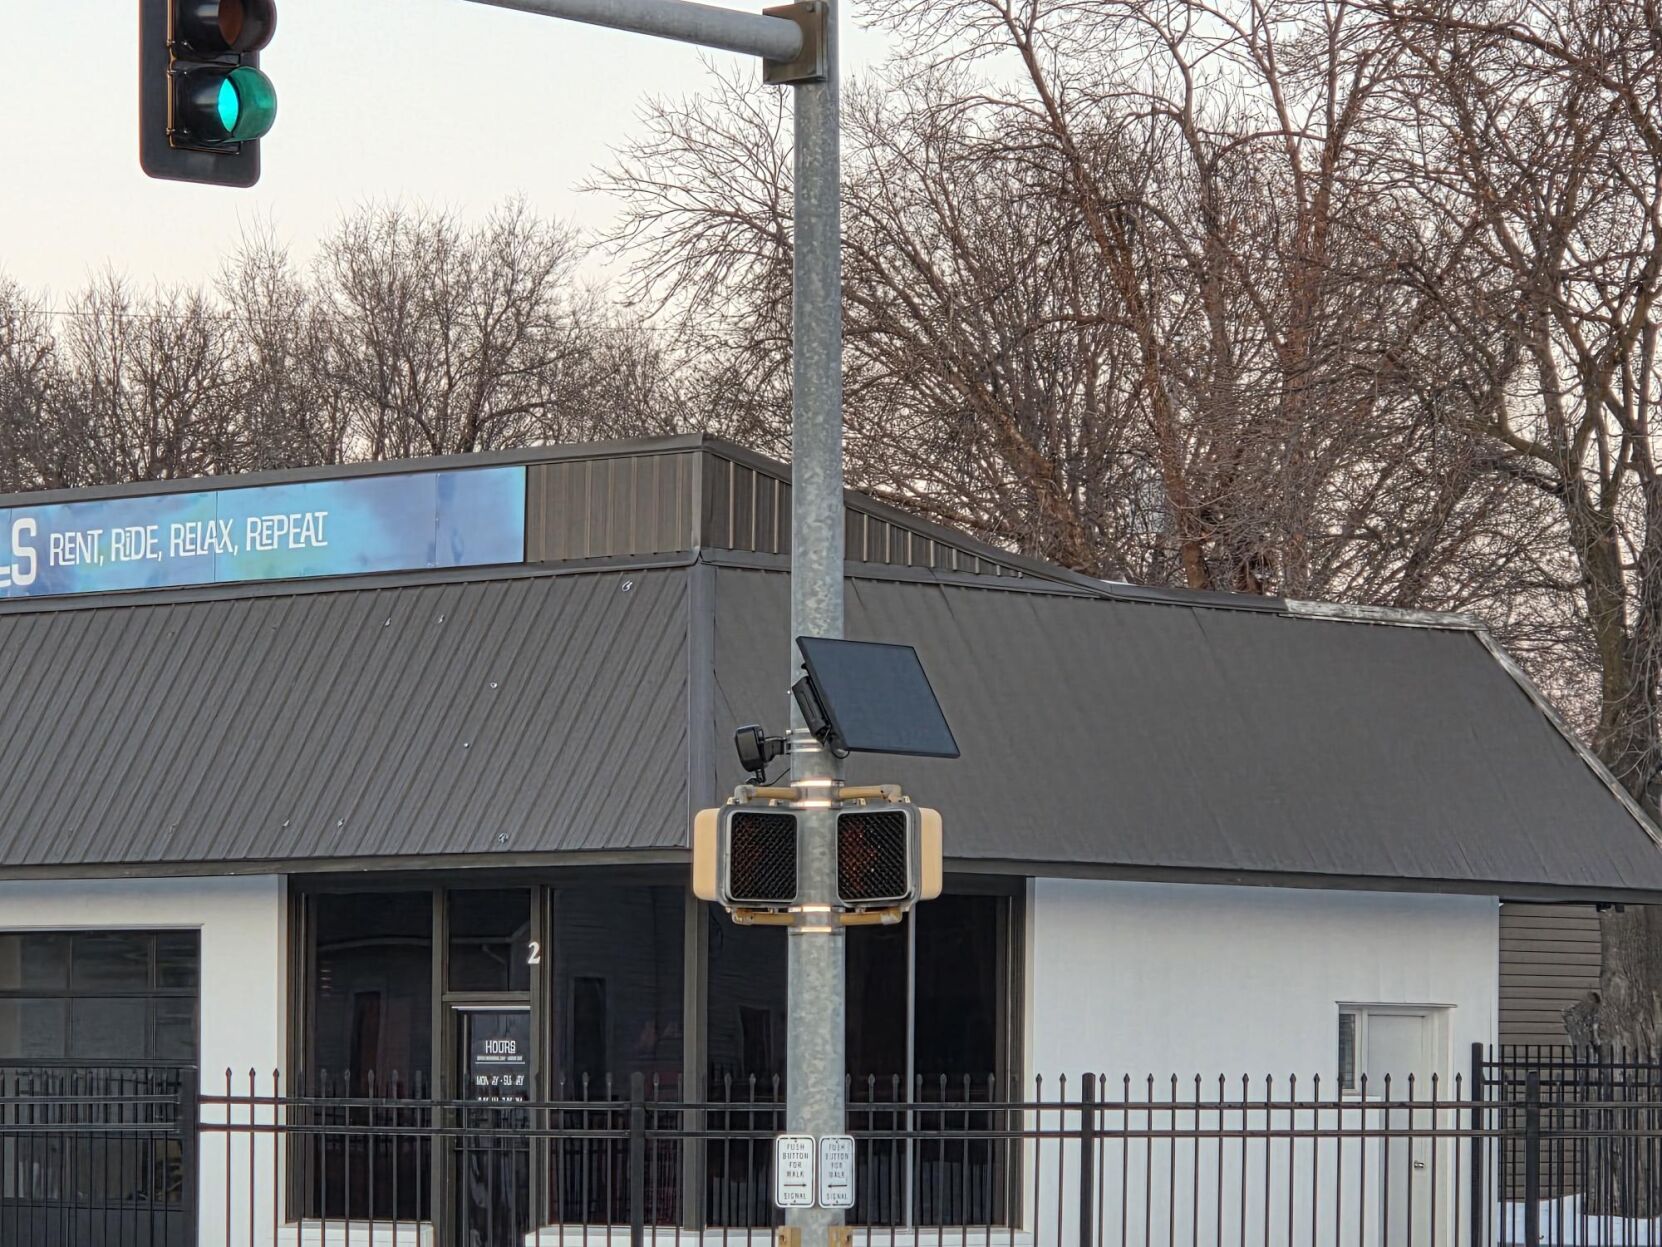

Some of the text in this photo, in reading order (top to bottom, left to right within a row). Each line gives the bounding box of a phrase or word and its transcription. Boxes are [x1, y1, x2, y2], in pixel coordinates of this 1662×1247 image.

[50, 529, 104, 567] RENT,
[170, 518, 239, 557] RELAX,
[246, 511, 329, 551] REPEAT
[527, 941, 541, 965] 2
[485, 1040, 516, 1054] HOURS
[786, 1143, 805, 1151] PUSH
[782, 1152, 809, 1160] BUTTON
[789, 1161, 802, 1169] FOR
[783, 1192, 807, 1200] SIGNAL
